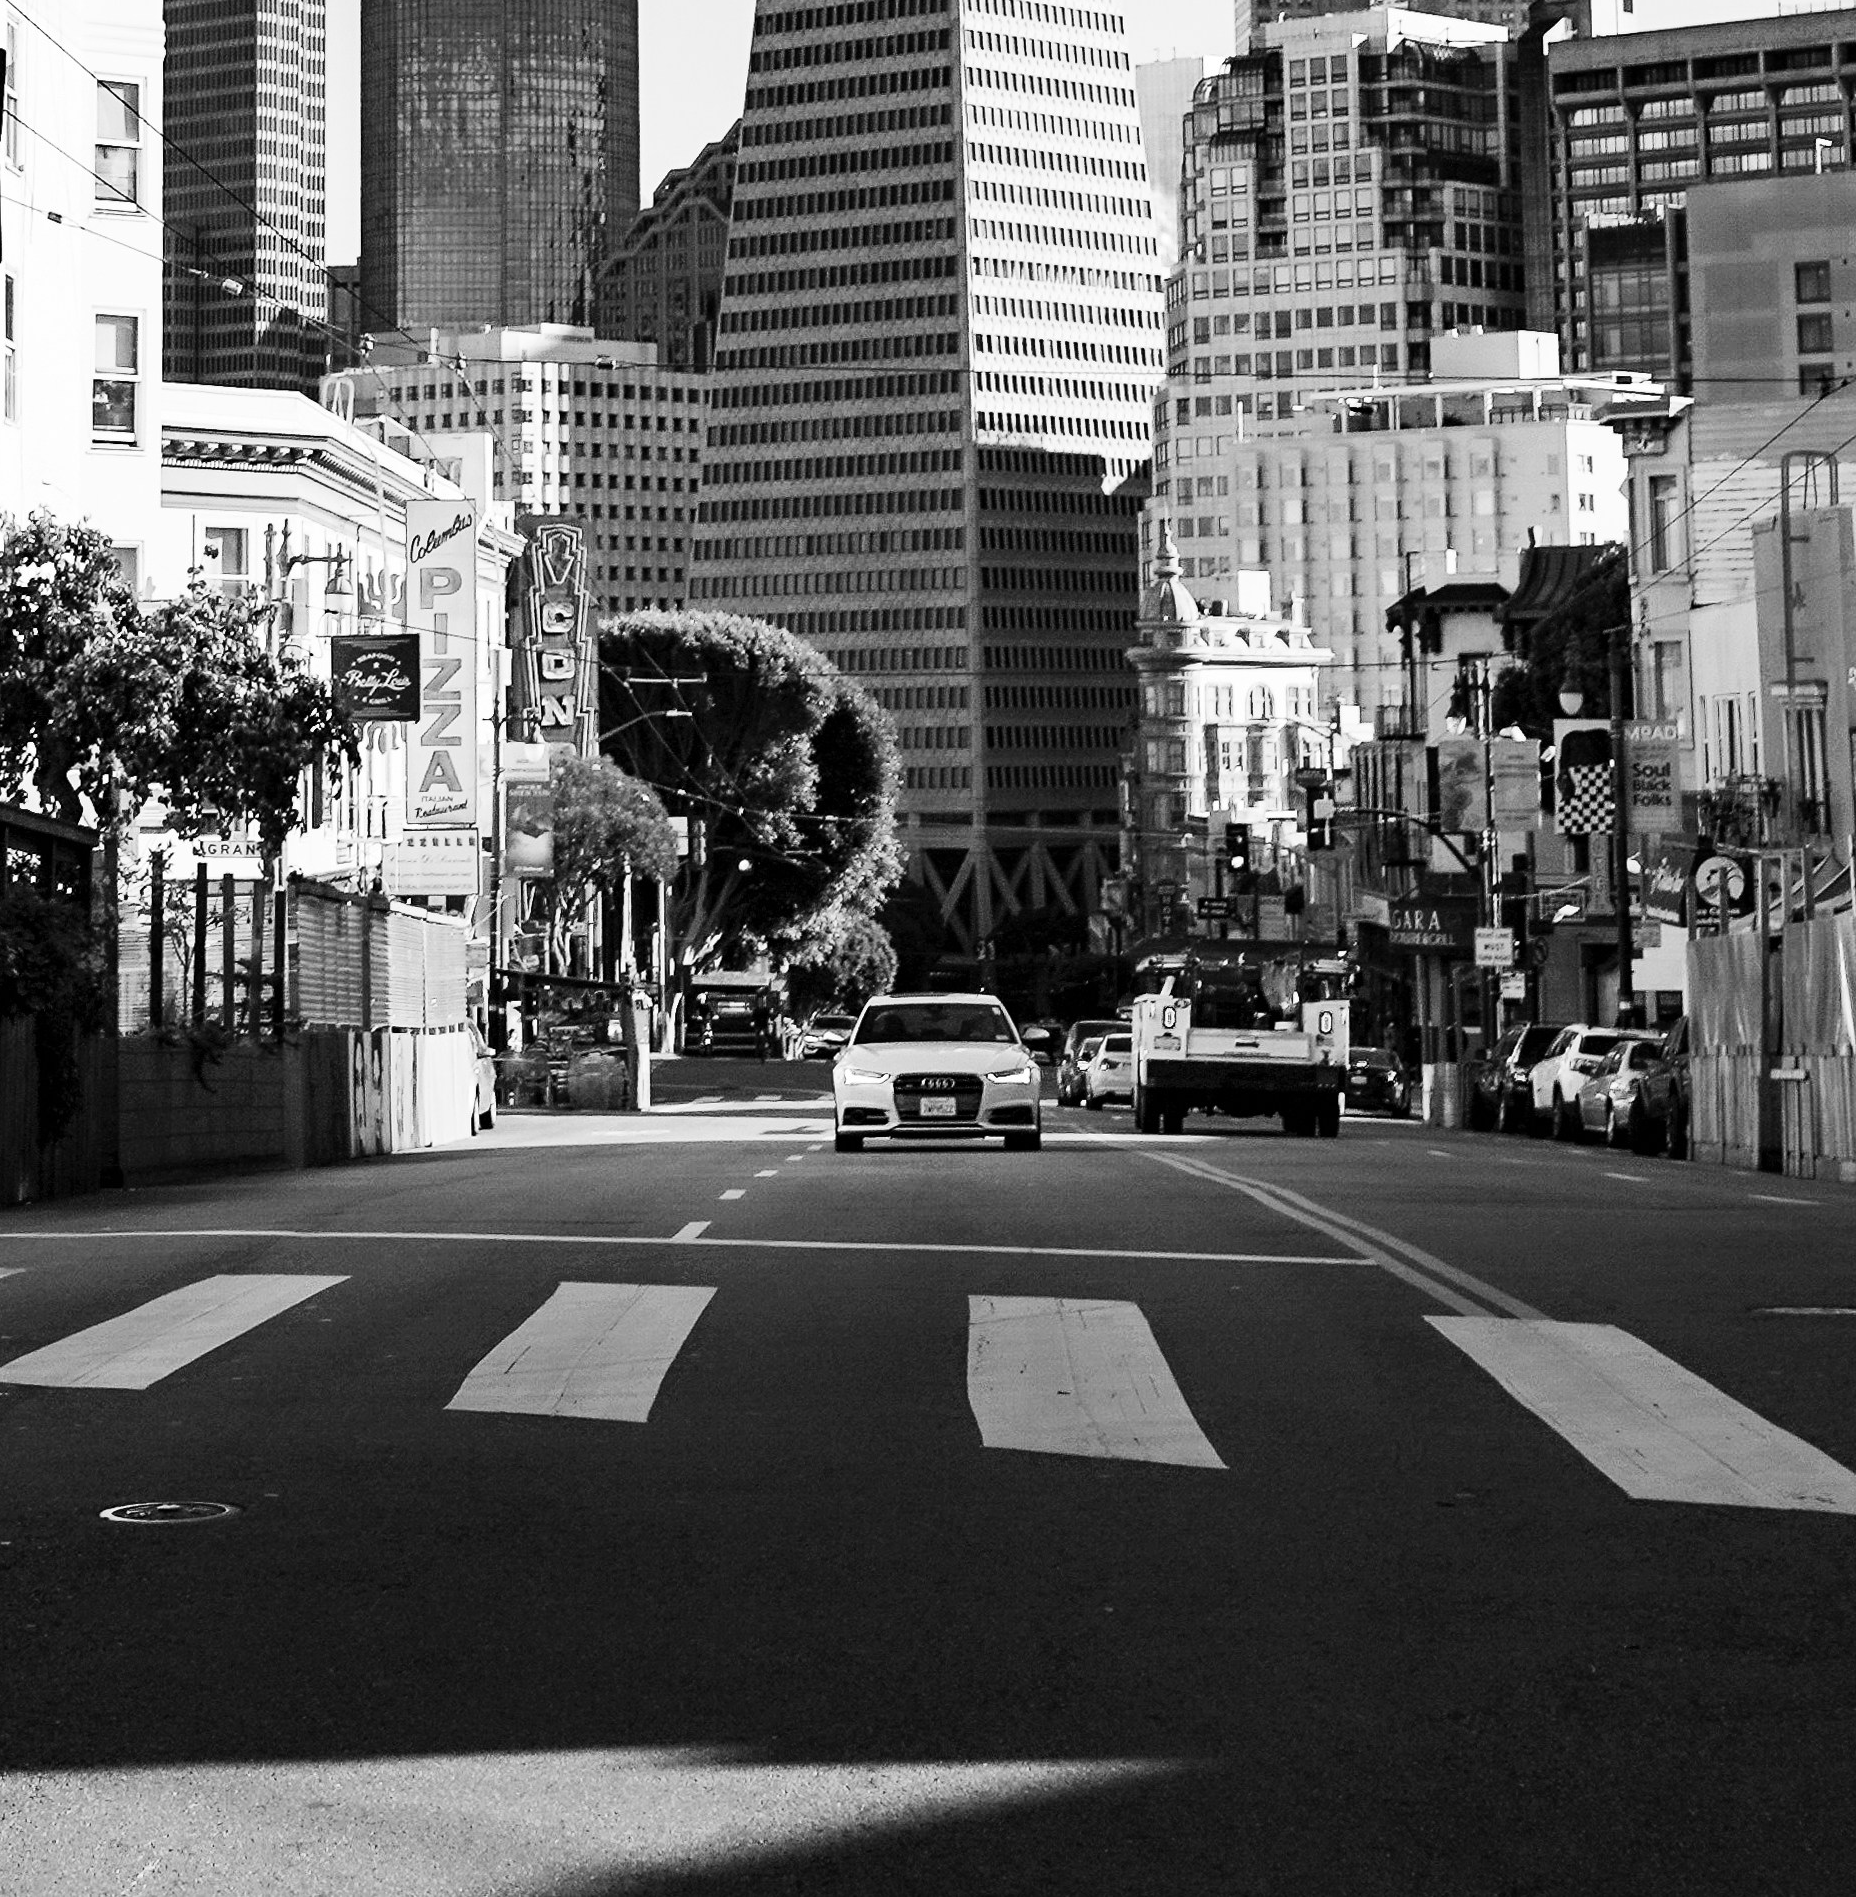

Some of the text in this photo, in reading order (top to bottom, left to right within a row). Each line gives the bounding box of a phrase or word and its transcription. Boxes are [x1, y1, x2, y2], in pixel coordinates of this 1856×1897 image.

[409, 514, 473, 563] Columbus
[418, 567, 463, 792] PIZZA
[540, 602, 576, 727] CON
[1632, 762, 1671, 778] Soul
[208, 843, 261, 857] GRAN
